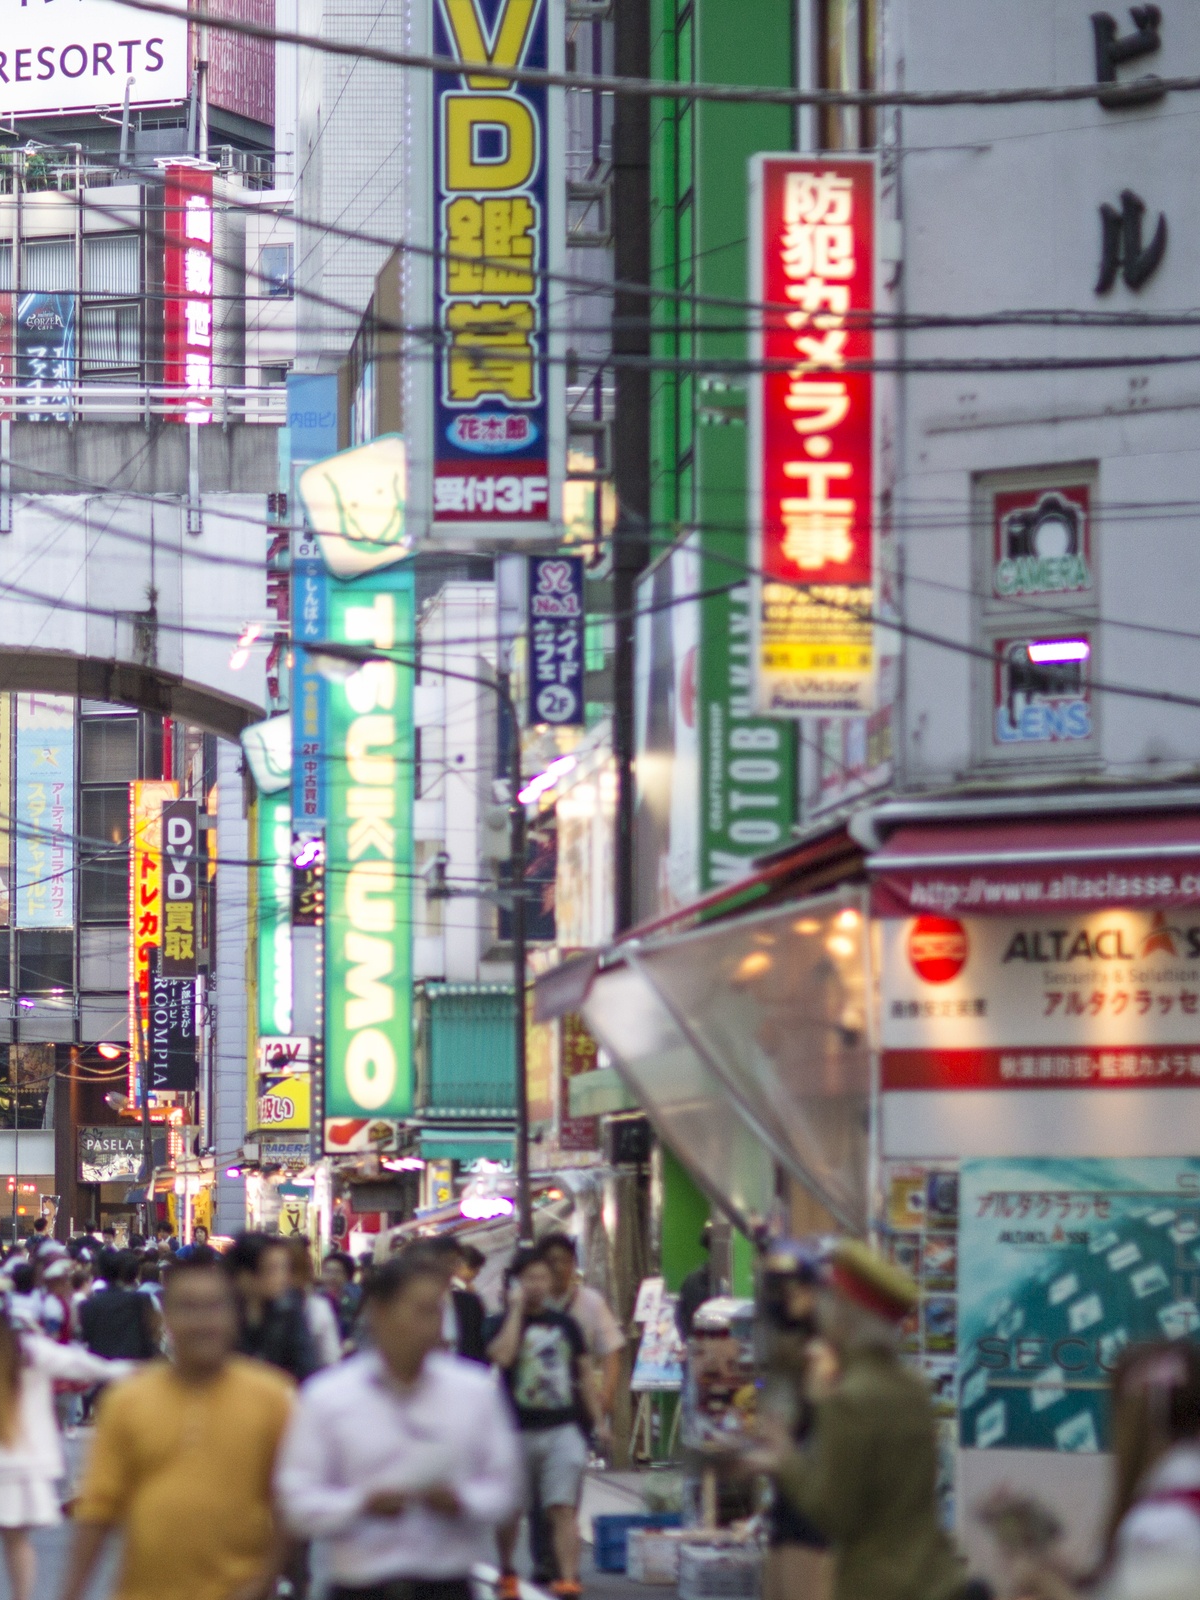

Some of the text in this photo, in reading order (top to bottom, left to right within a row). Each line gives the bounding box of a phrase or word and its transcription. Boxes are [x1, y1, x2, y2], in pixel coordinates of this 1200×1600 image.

[780, 170, 855, 571] 防犯カメラ・工事
[457, 416, 529, 441] 花太郎
[434, 475, 548, 513] 受付3F
[996, 555, 1092, 595] CAMERA
[544, 691, 570, 713] 2F
[997, 701, 1091, 742] LENS
[302, 743, 319, 755] 2F
[304, 760, 318, 815] 中古買取
[344, 593, 397, 1111] TSUKUMO
[164, 817, 195, 961] DVD買取
[1043, 988, 1199, 1017] アルタクラッセ
[153, 977, 168, 1086] ROOMPIA
[87, 1139, 134, 1151] PASELA
[976, 1192, 1112, 1219] アルタクラッセ
